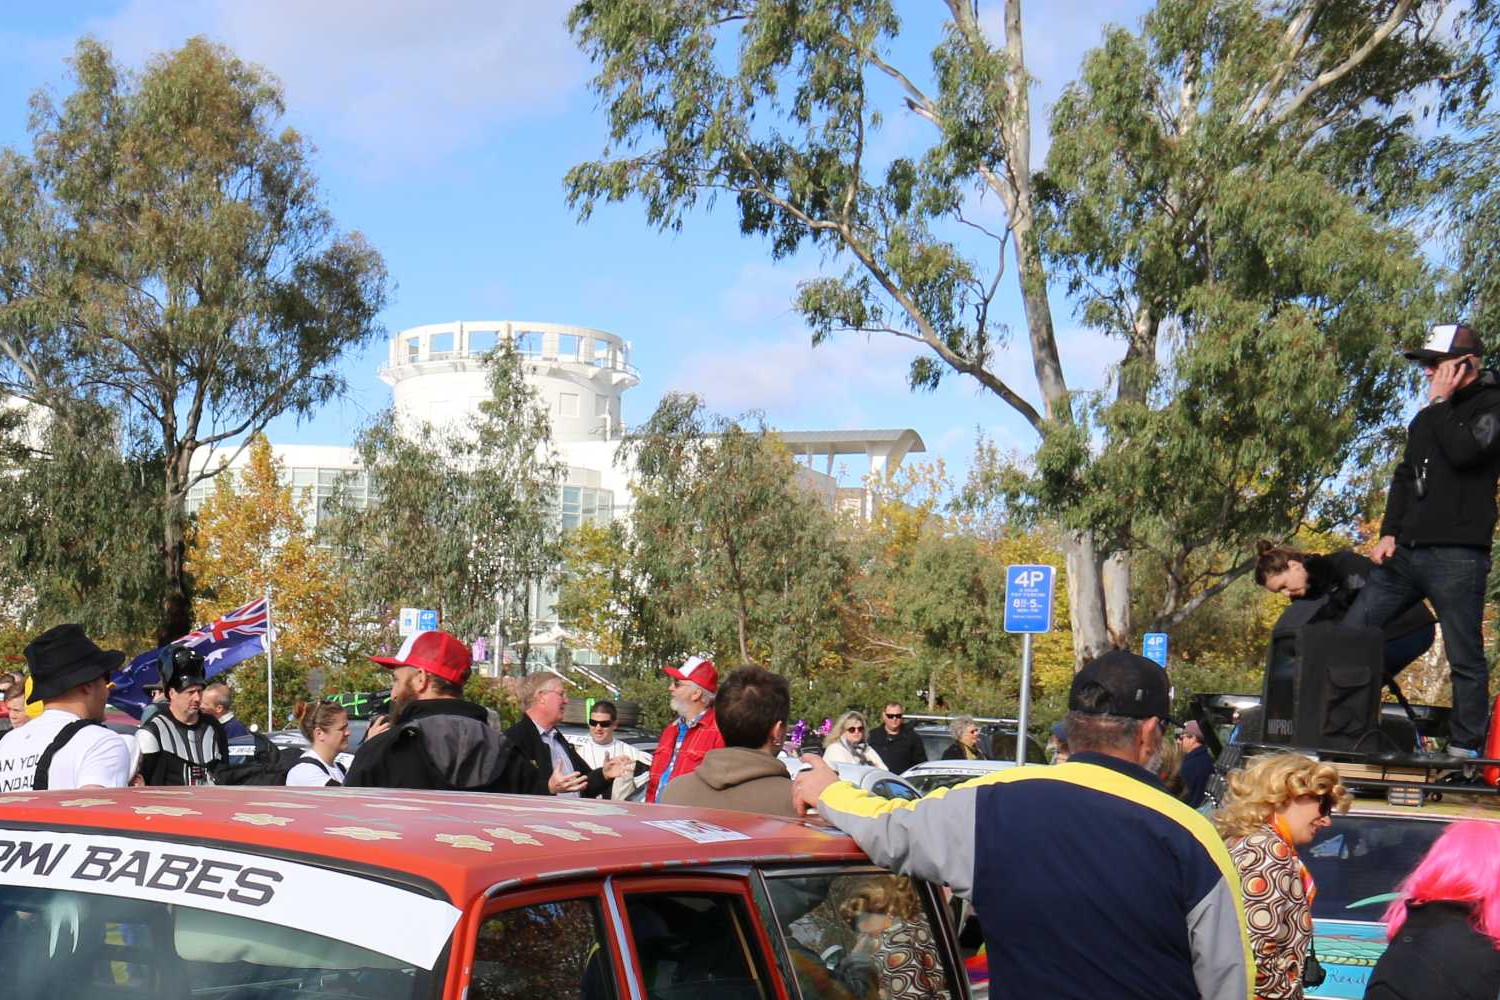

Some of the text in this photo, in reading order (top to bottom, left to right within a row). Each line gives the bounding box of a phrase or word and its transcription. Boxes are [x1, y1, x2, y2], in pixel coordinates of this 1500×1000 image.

[1014, 571, 1044, 587] 4P
[1148, 636, 1163, 646] 4P
[71, 846, 284, 908] BABES
